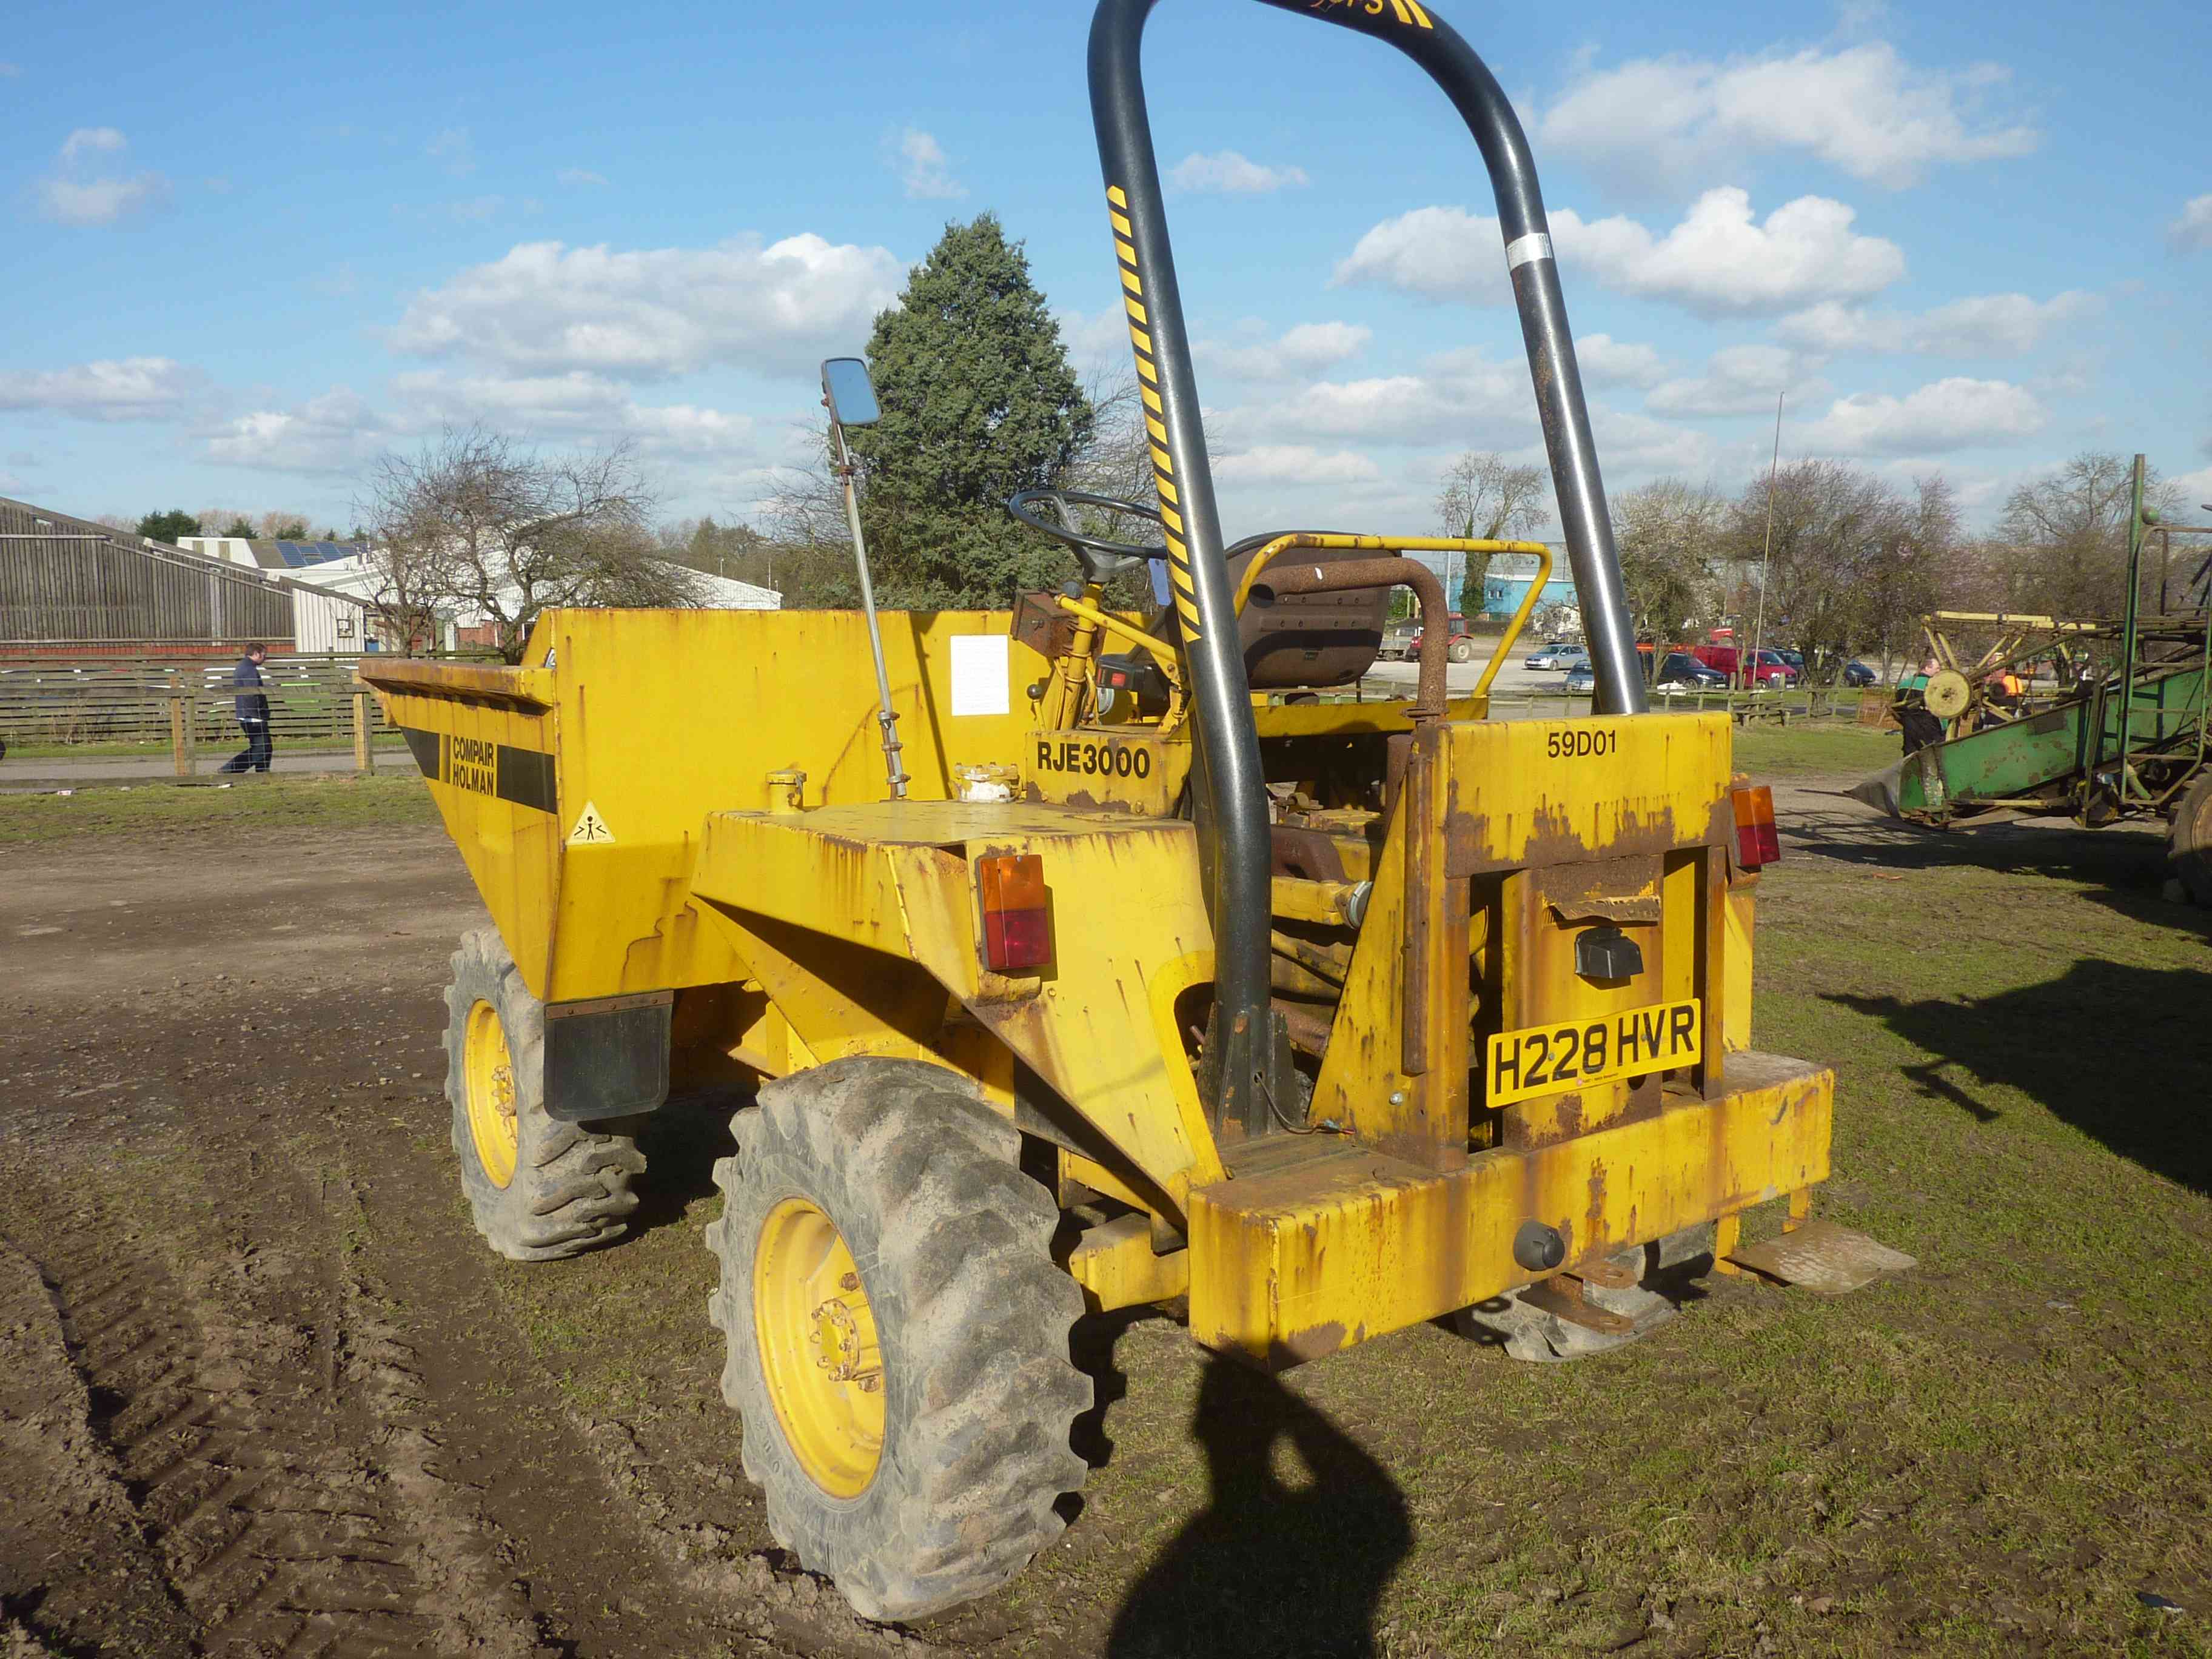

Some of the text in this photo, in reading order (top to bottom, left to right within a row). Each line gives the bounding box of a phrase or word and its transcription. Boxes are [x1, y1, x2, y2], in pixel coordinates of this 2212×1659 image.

[453, 736, 494, 767] COMPAIR
[1037, 741, 1150, 779] RJE3000
[1547, 729, 1616, 758] 59D01
[453, 763, 494, 796] HOLMAN
[1495, 1004, 1695, 1094] H228 HVR
